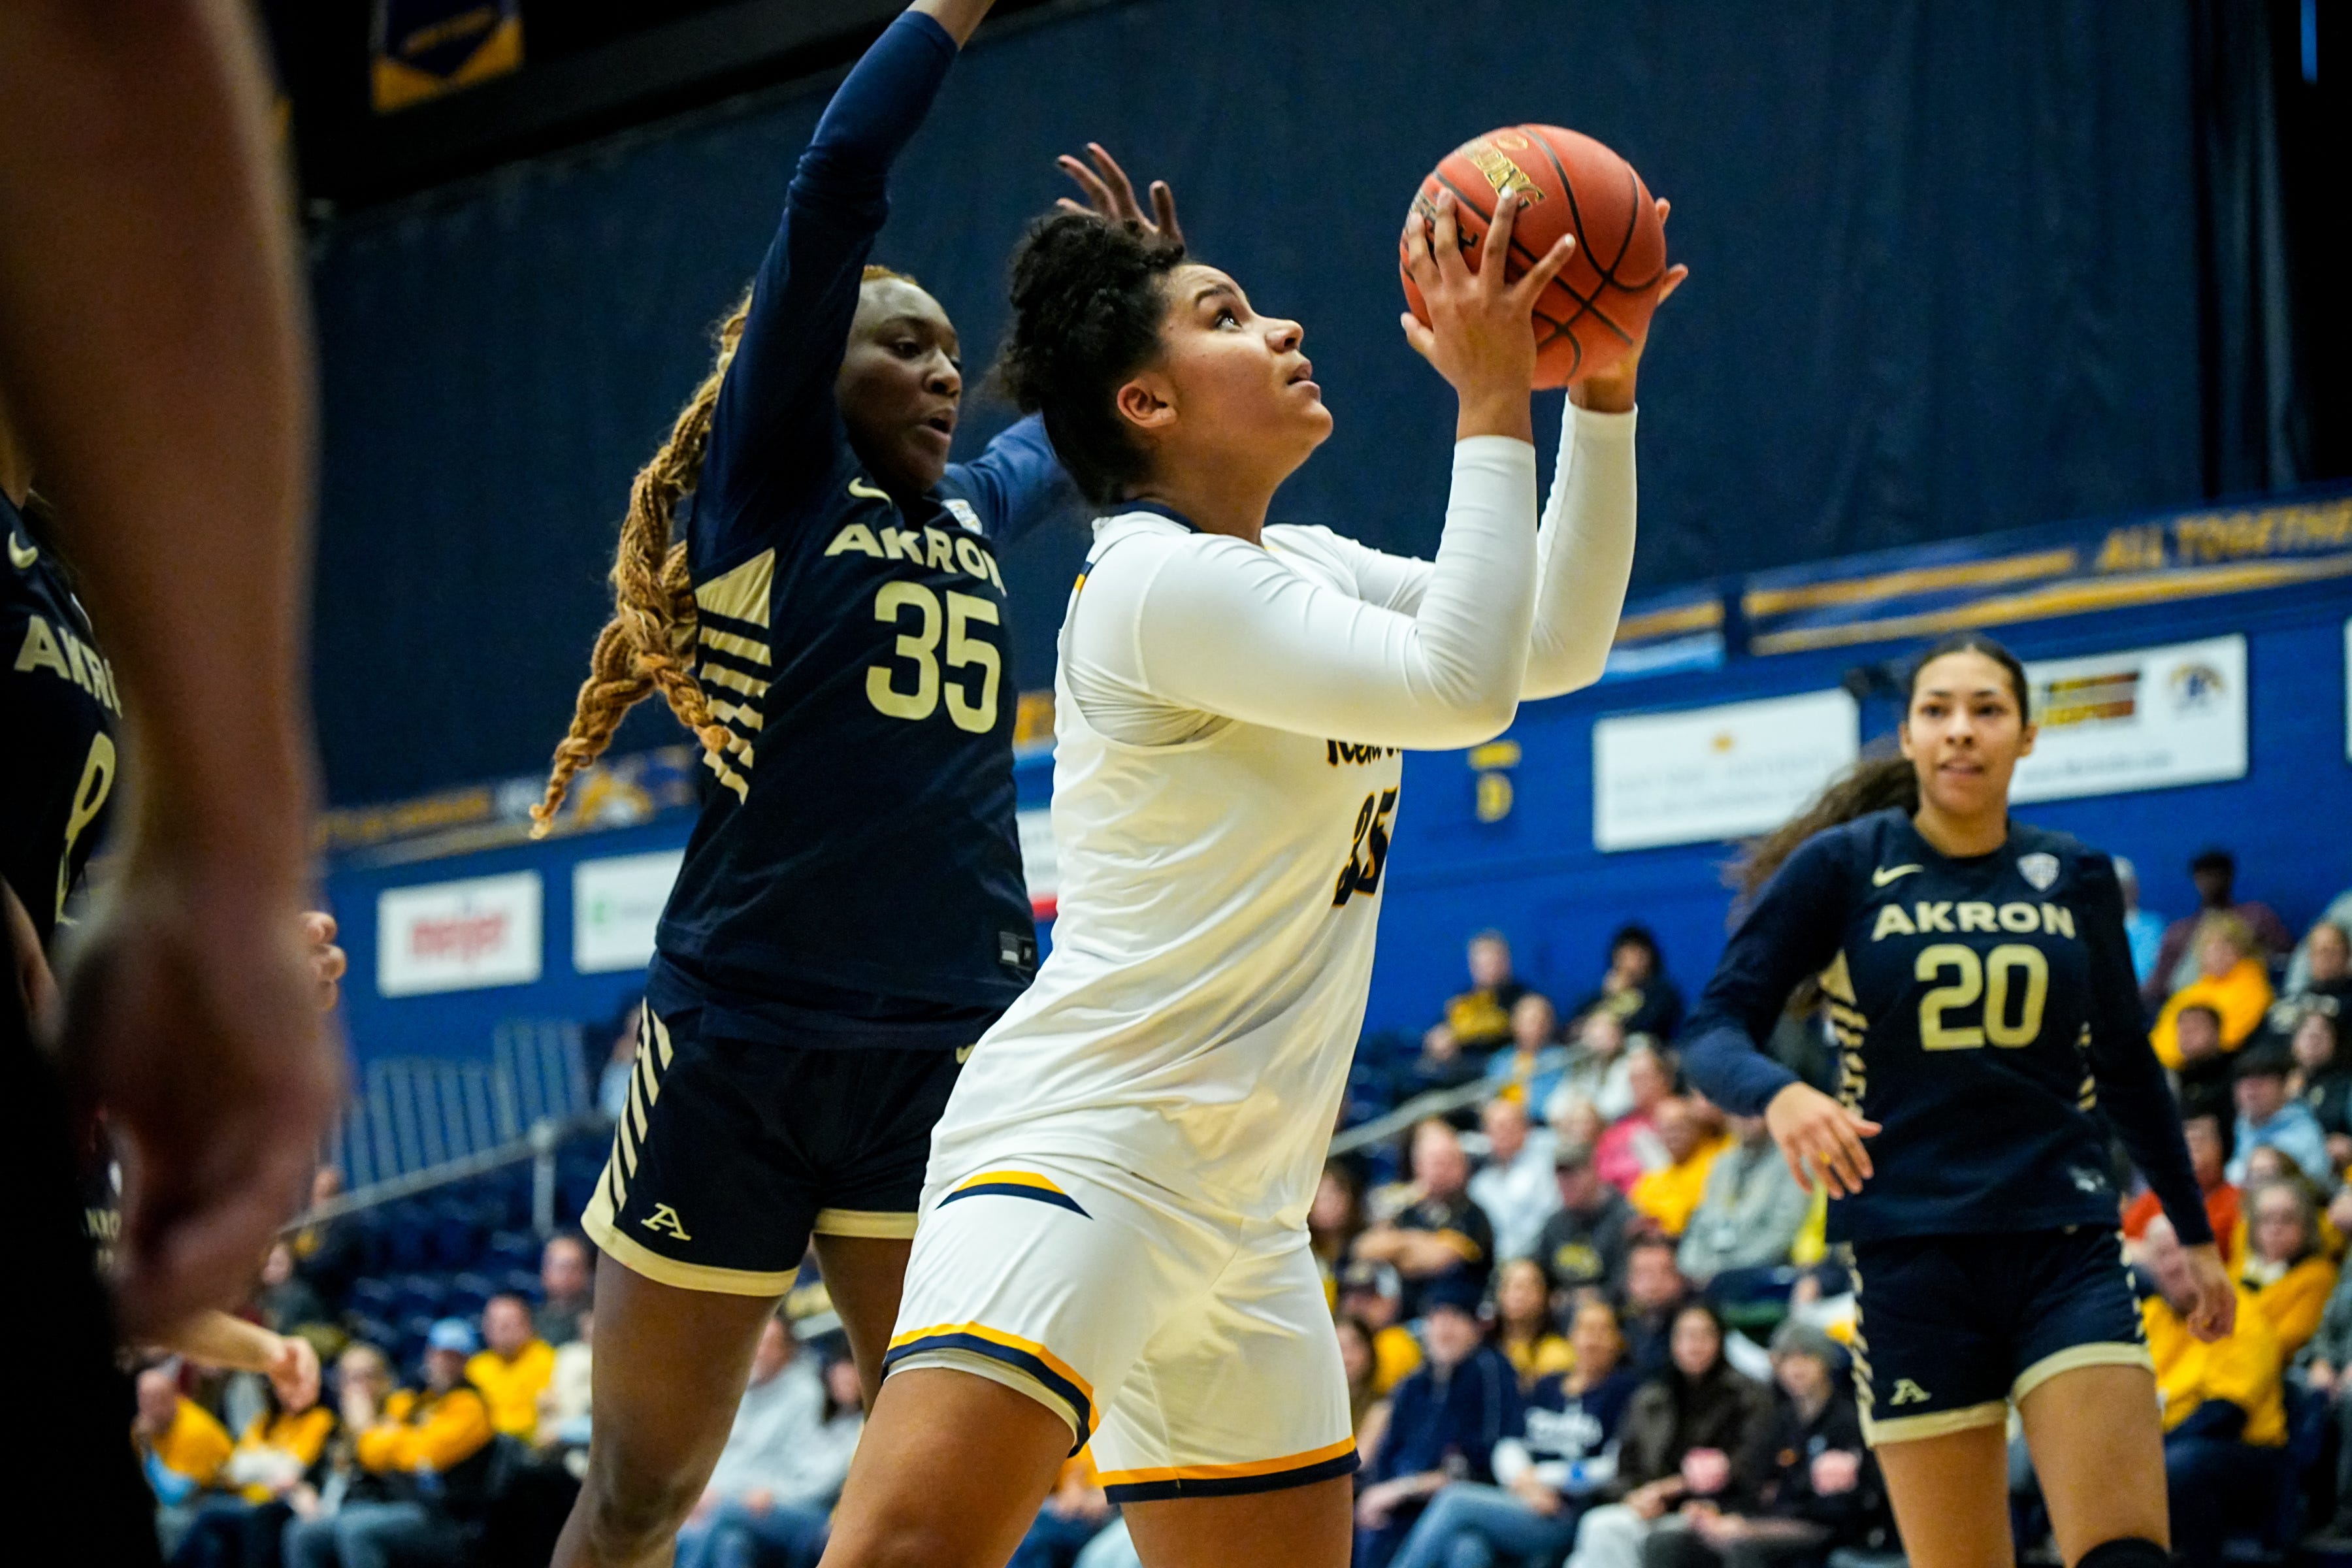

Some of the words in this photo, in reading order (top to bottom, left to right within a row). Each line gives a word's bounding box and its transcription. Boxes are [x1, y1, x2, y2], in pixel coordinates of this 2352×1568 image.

[866, 581, 1001, 734] 35
[1870, 901, 2076, 942] AKRON
[1914, 943, 2050, 1052] 20
[640, 1202, 692, 1241] A
